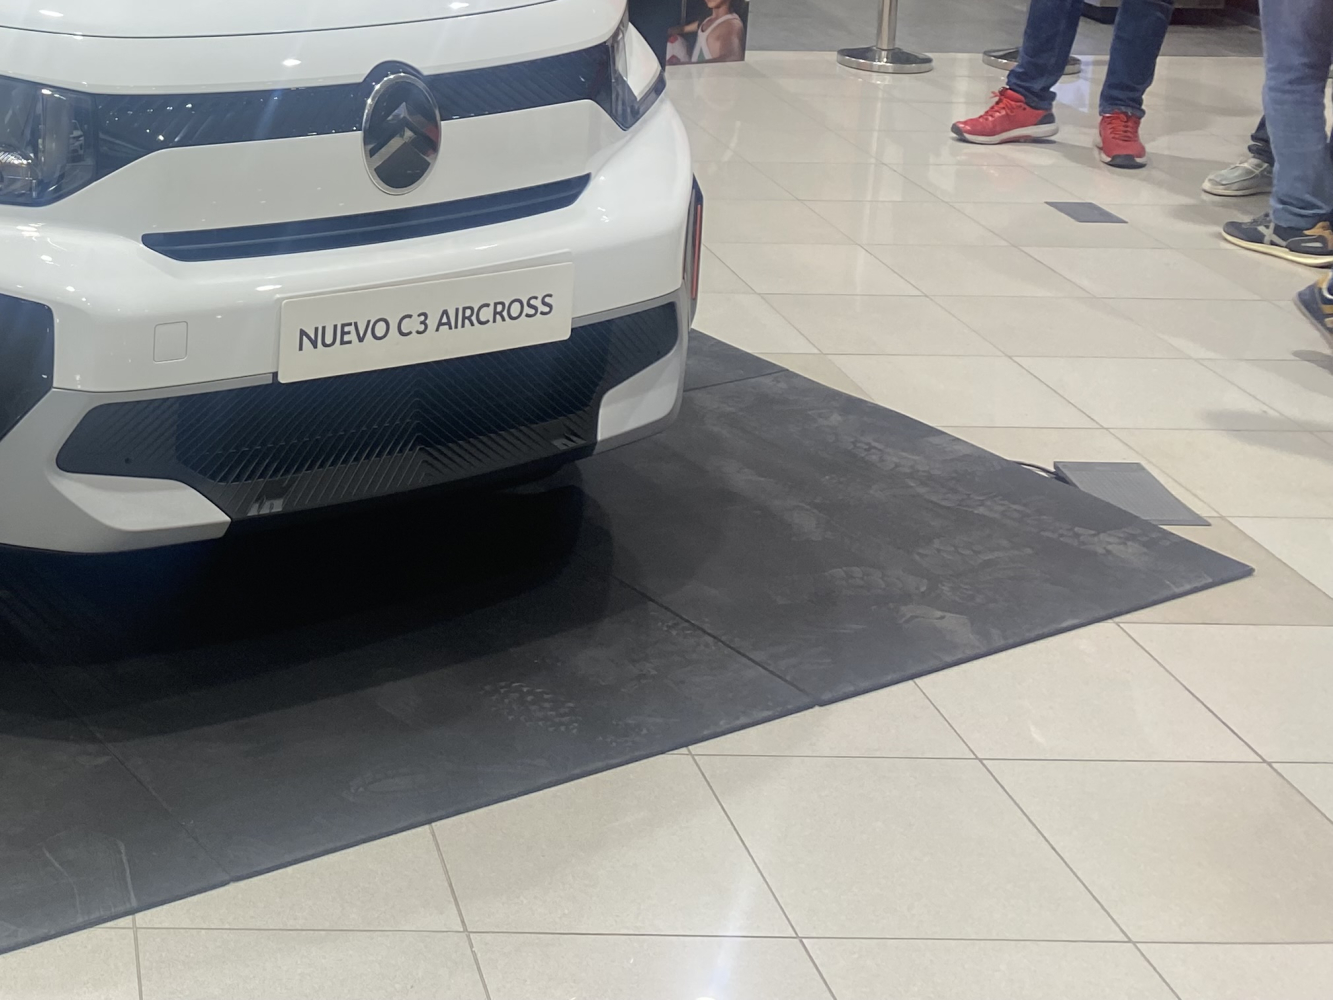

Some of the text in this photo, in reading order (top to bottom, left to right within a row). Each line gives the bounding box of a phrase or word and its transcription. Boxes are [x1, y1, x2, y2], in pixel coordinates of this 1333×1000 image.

[298, 293, 554, 351] NUEVO C3 AIRCROSS
